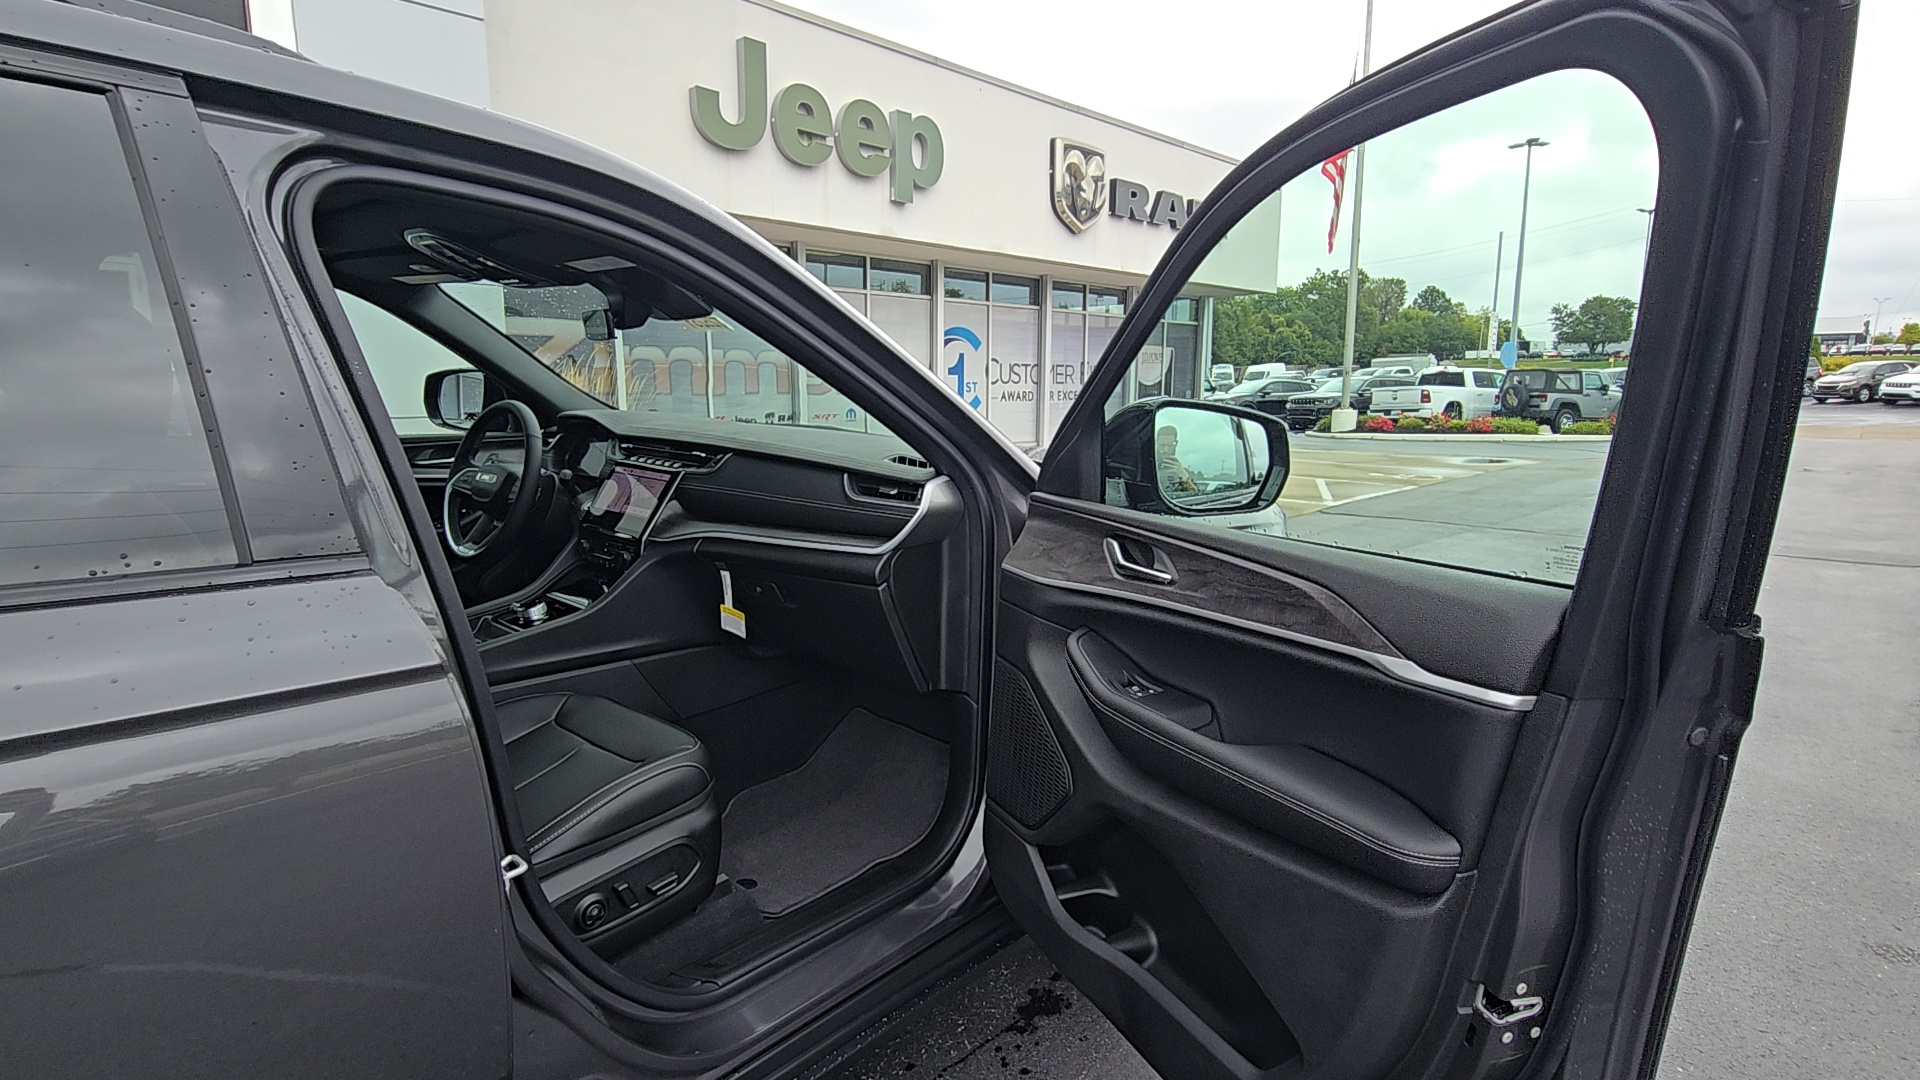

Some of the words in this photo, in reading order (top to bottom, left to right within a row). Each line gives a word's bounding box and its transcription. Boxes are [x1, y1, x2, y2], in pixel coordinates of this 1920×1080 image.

[689, 35, 945, 204] Jeep
[1108, 177, 1200, 230] RA
[1000, 390, 1035, 402] AWARD
[811, 413, 840, 421] SRT
